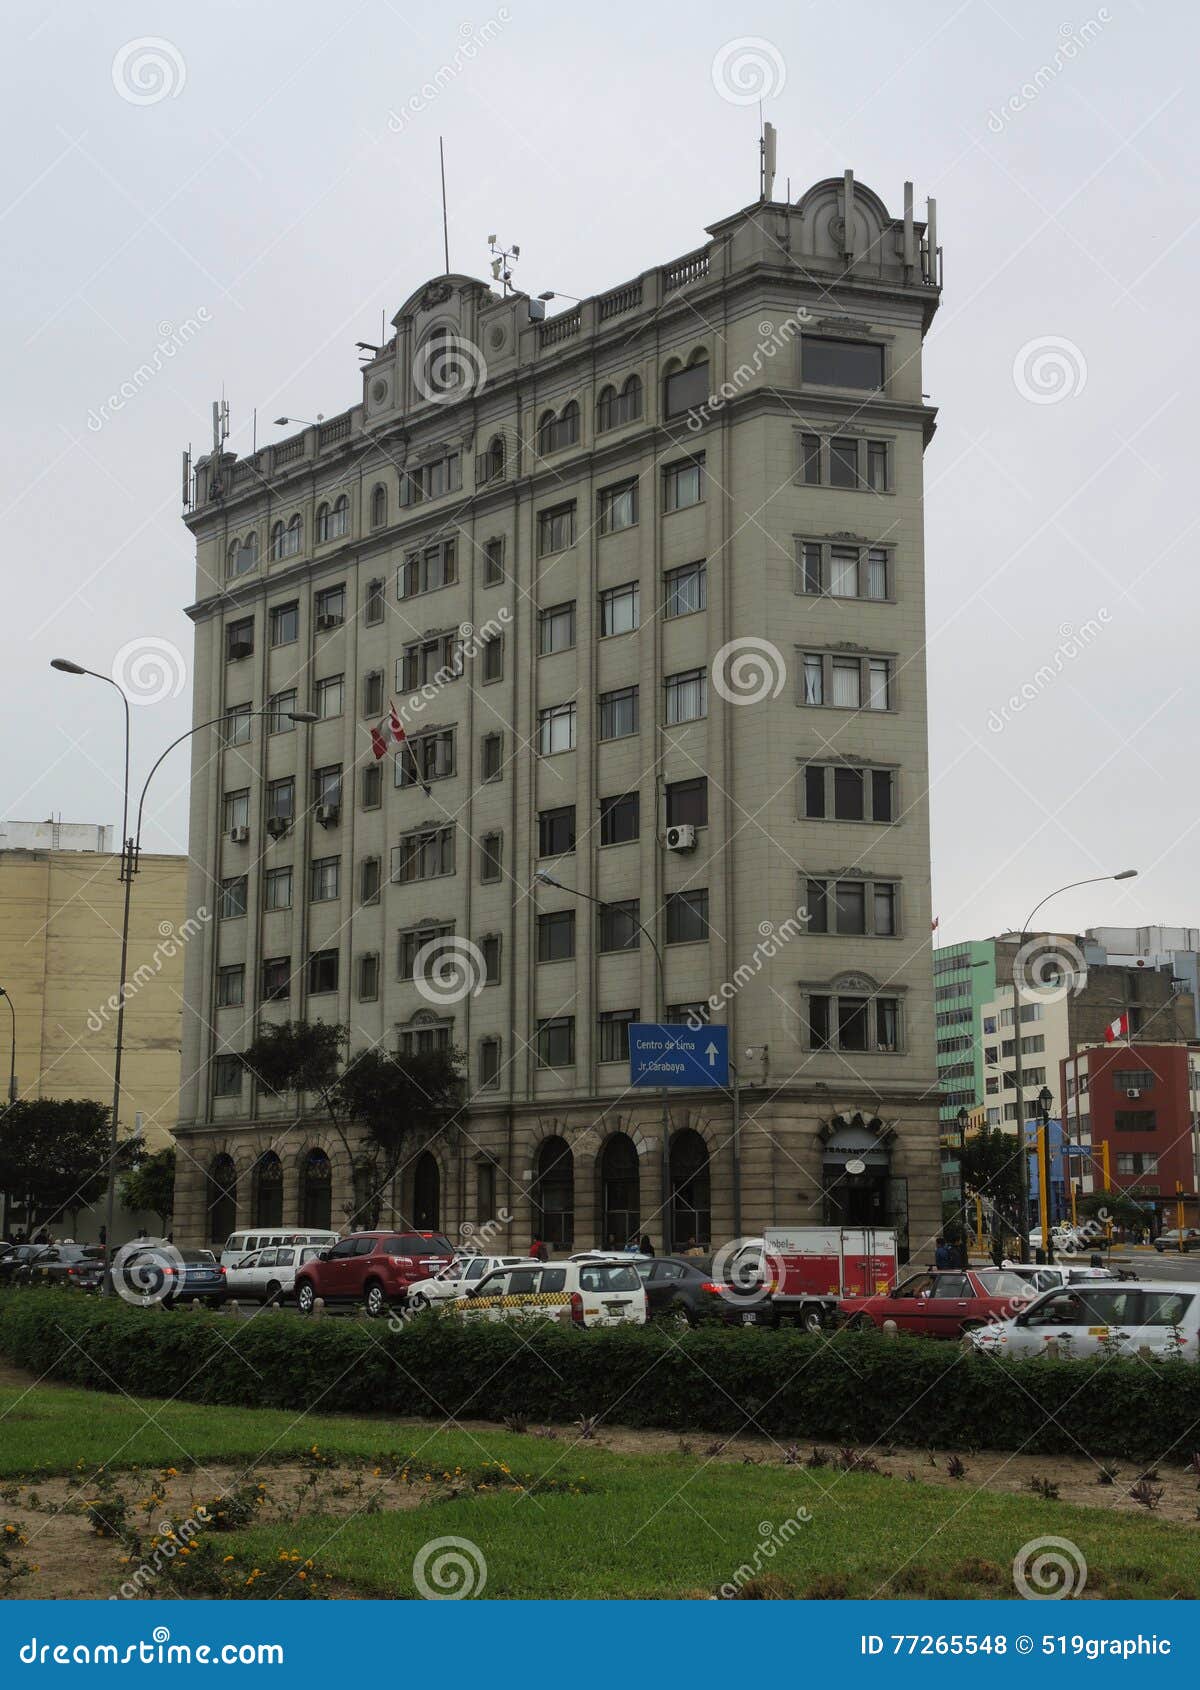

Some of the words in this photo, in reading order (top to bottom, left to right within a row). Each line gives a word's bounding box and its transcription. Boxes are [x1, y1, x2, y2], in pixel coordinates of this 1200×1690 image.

[636, 1039, 663, 1050] Centro
[664, 1041, 674, 1050] de
[675, 1040, 695, 1050] Lima
